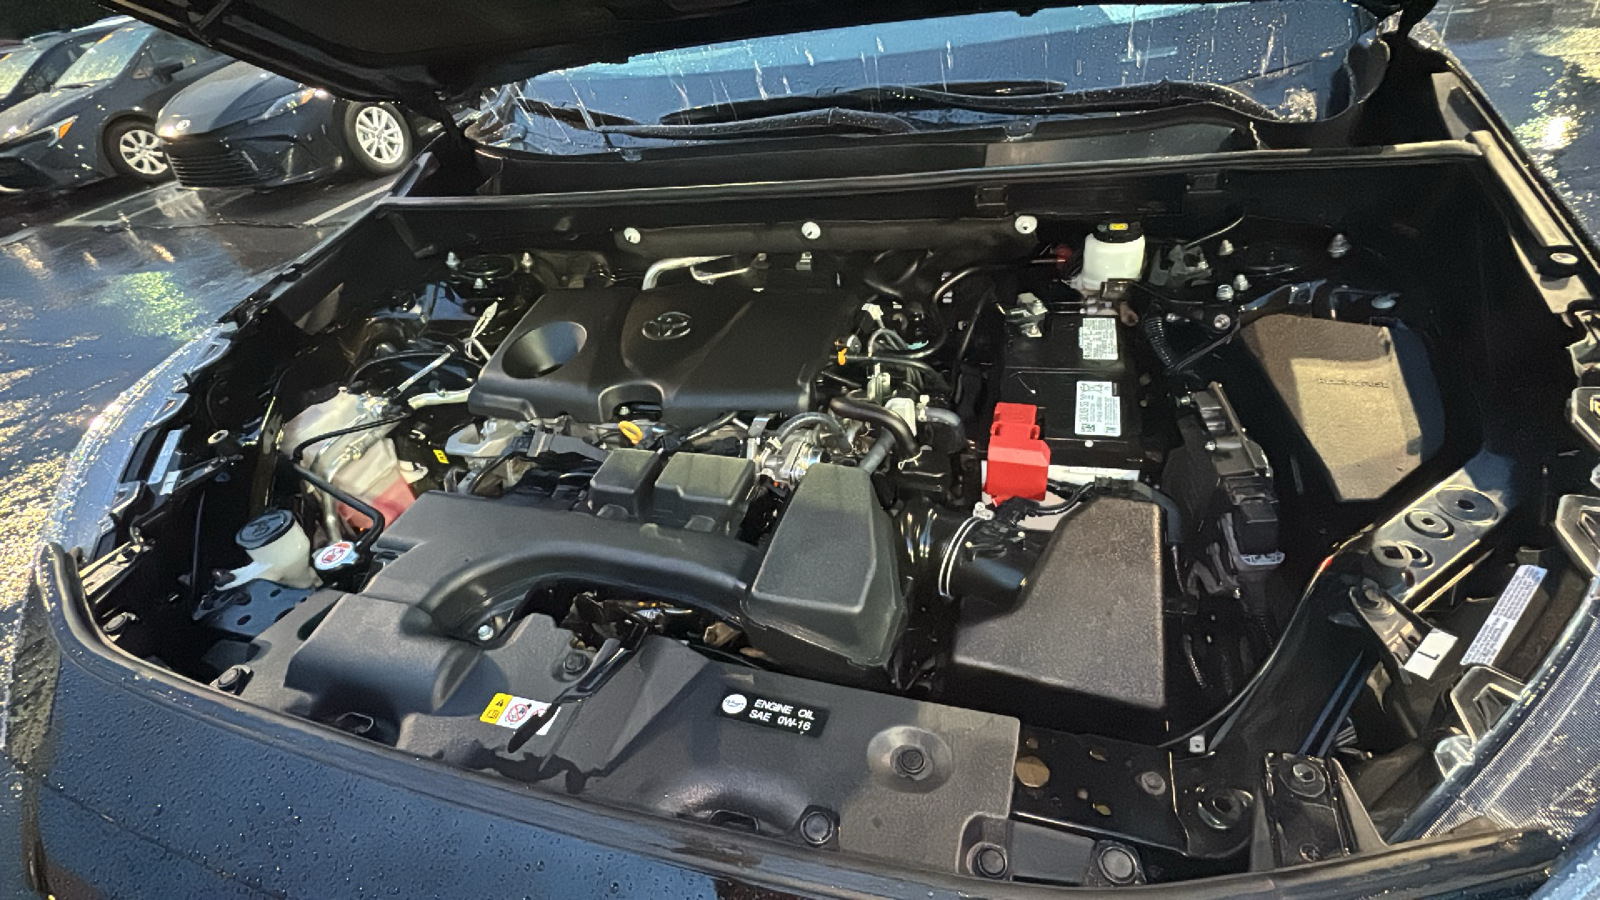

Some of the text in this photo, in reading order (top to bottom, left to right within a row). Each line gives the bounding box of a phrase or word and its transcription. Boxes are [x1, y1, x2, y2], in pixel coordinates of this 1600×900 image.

[749, 709, 811, 730] SAE 0W-16
[754, 699, 815, 720] ENGINE OIL
